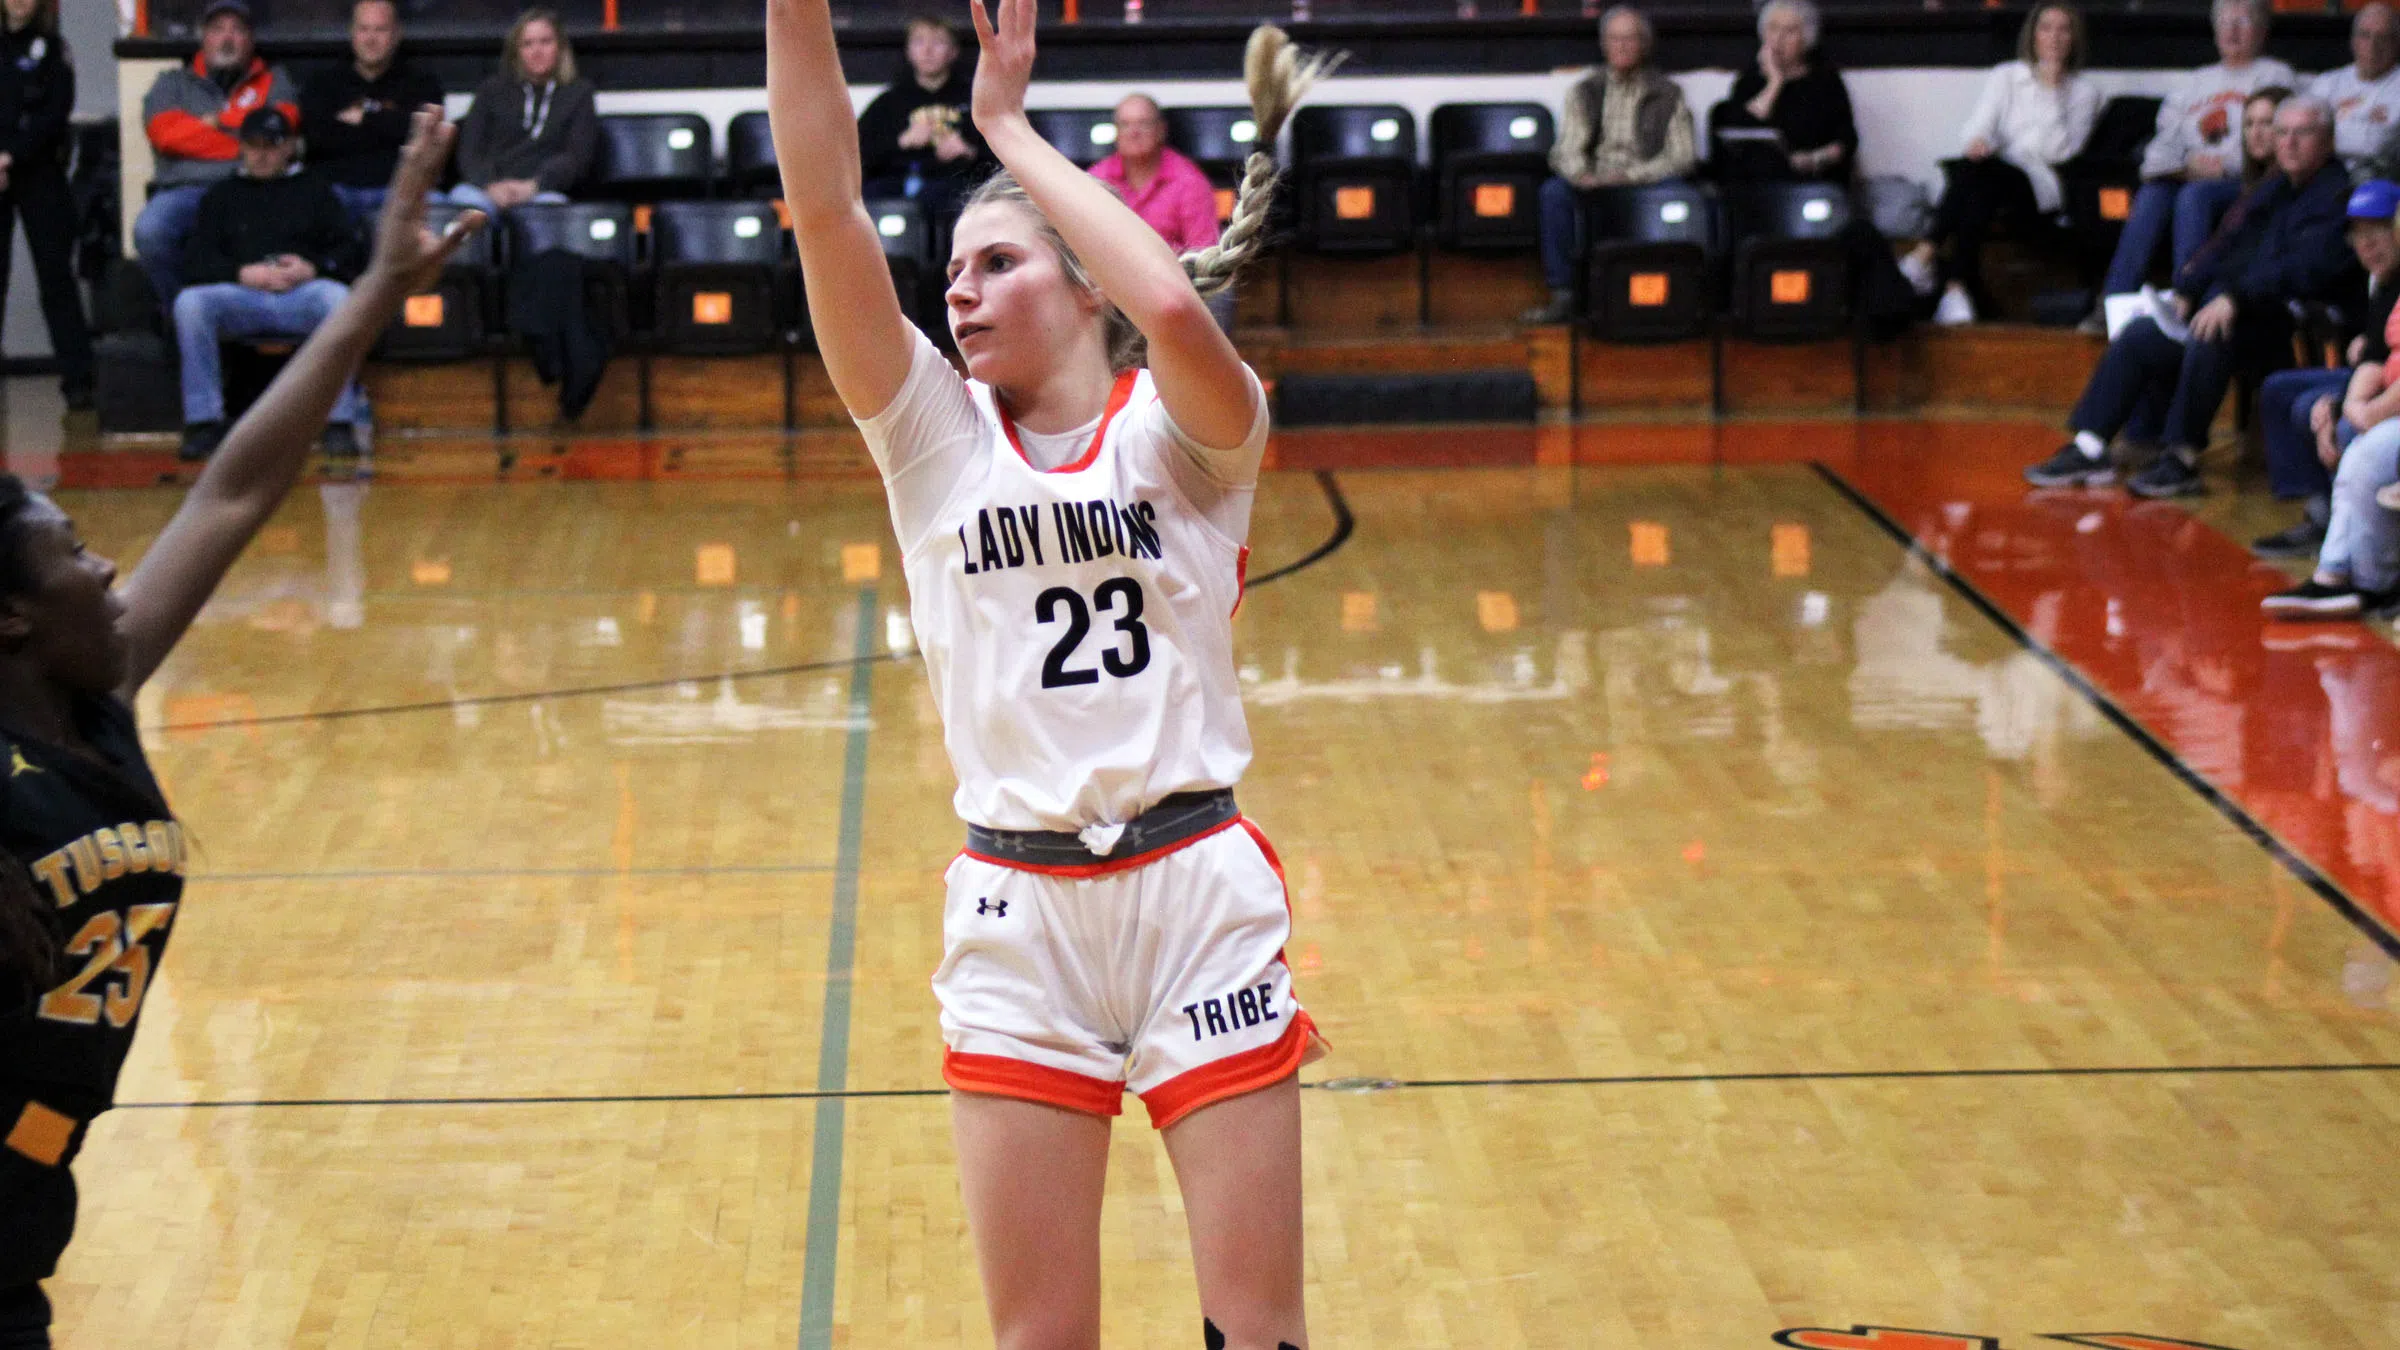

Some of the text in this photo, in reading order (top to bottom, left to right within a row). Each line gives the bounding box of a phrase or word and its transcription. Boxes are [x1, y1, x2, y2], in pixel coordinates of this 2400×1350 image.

[958, 504, 1044, 574] LADY
[1035, 576, 1151, 688] 23
[36, 902, 175, 1028] 25
[1183, 983, 1278, 1041] TRIBE
